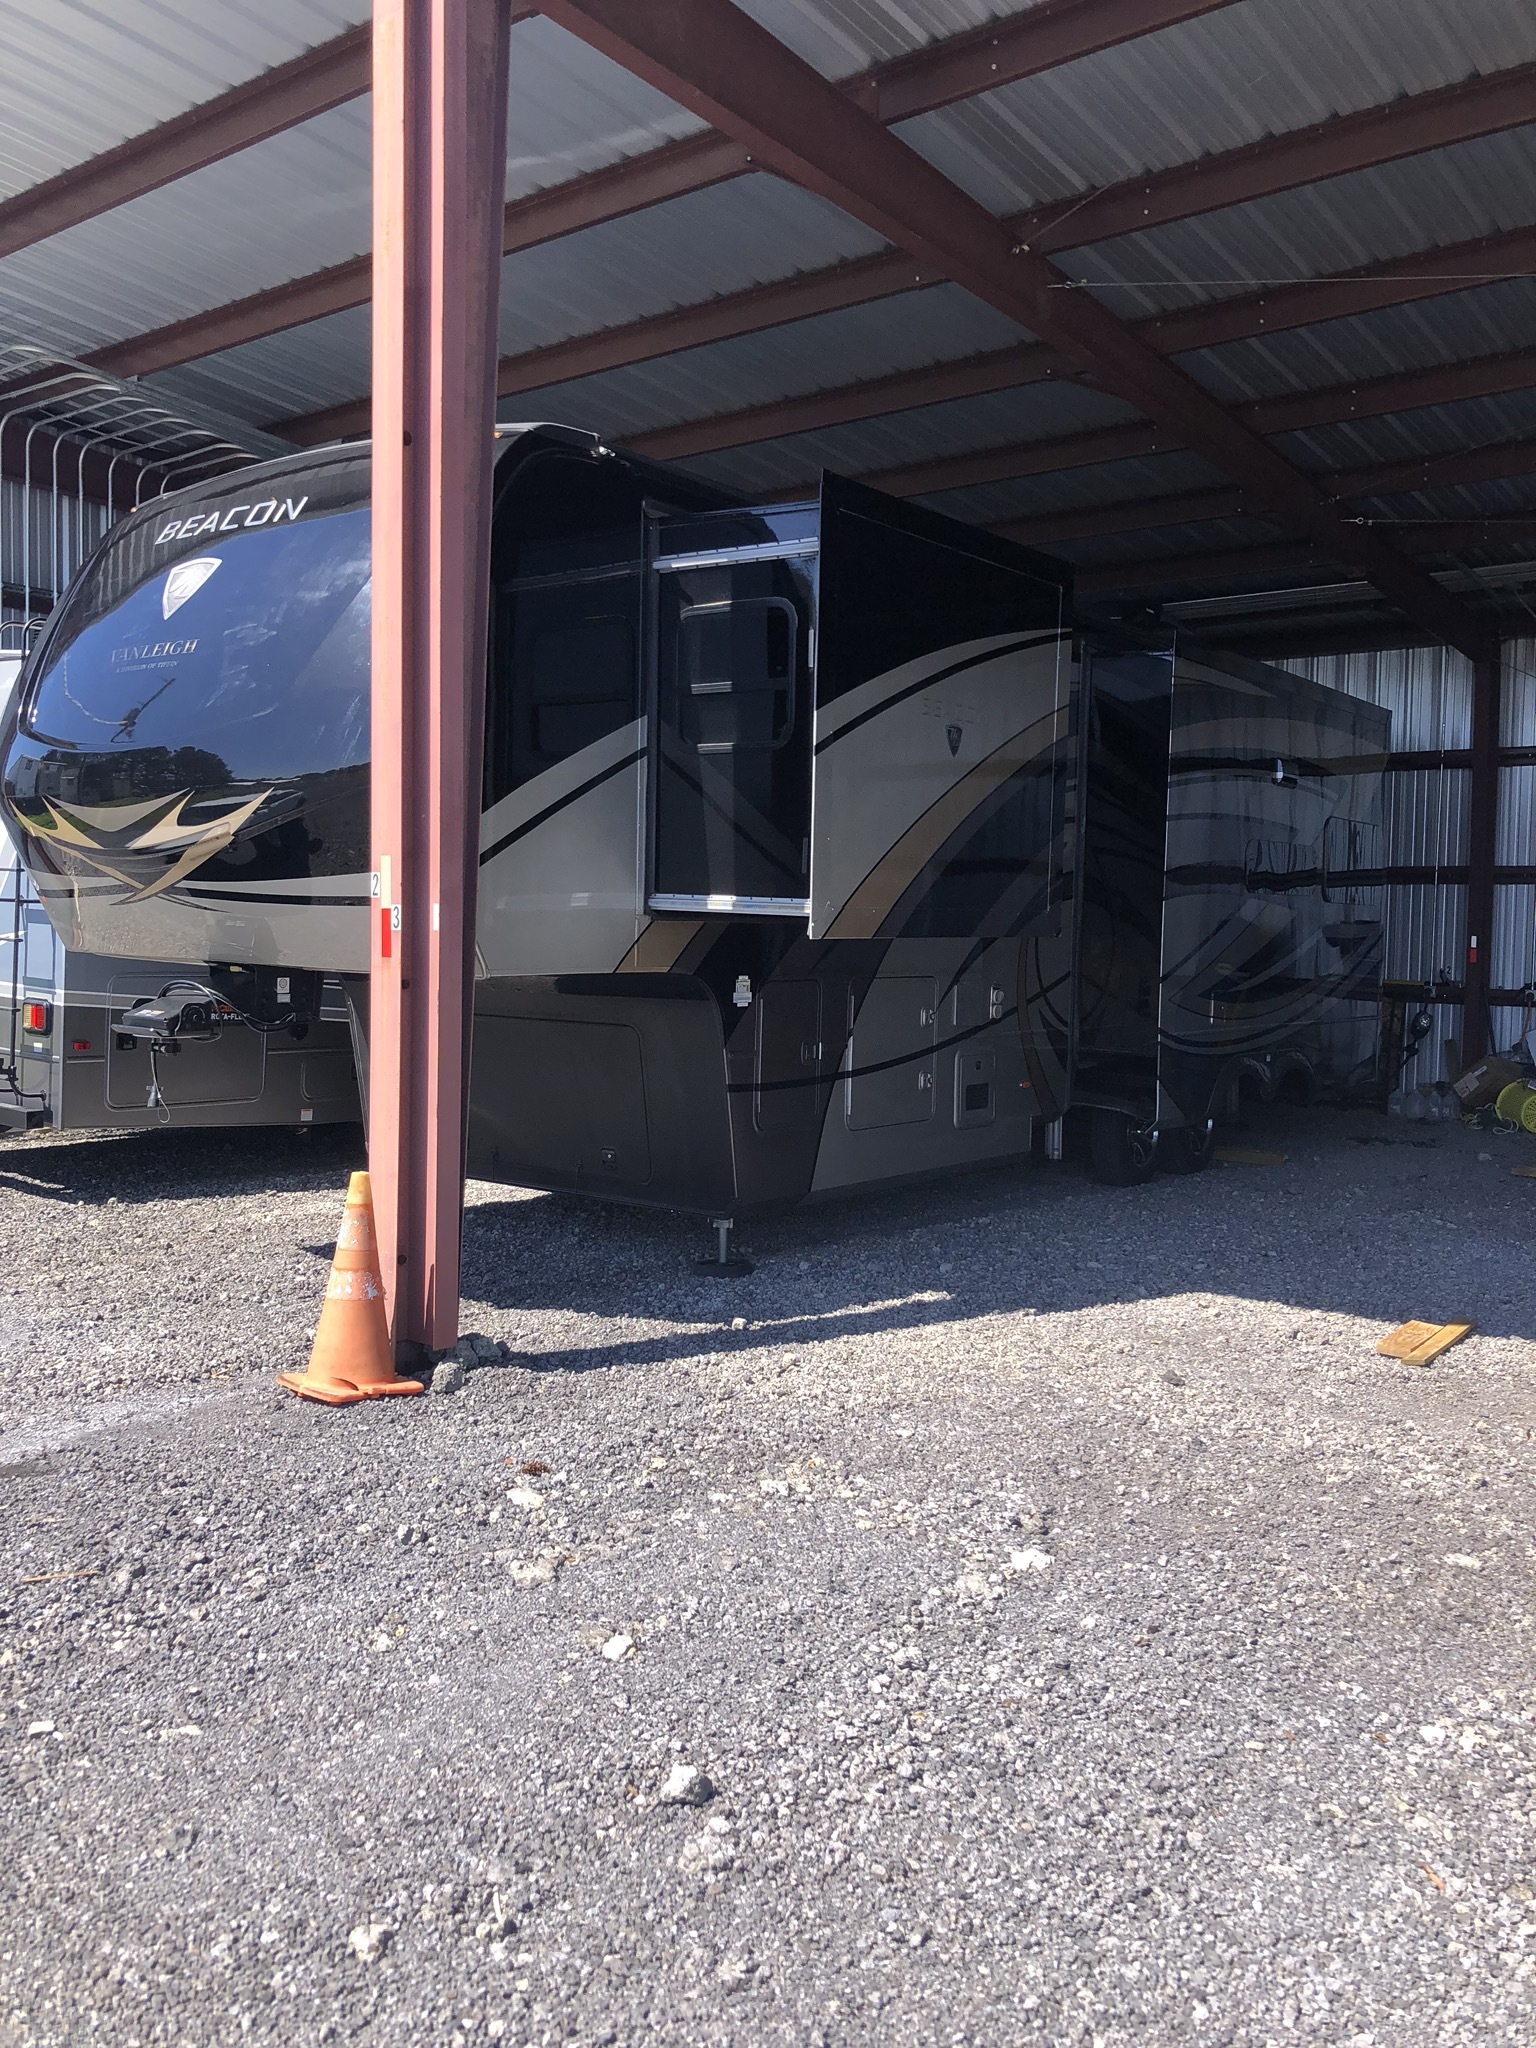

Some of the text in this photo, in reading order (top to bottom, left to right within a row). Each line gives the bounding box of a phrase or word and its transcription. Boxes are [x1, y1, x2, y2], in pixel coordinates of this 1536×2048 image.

[154, 496, 309, 545] BEACON
[372, 873, 379, 897] 2
[392, 905, 400, 929] 3
